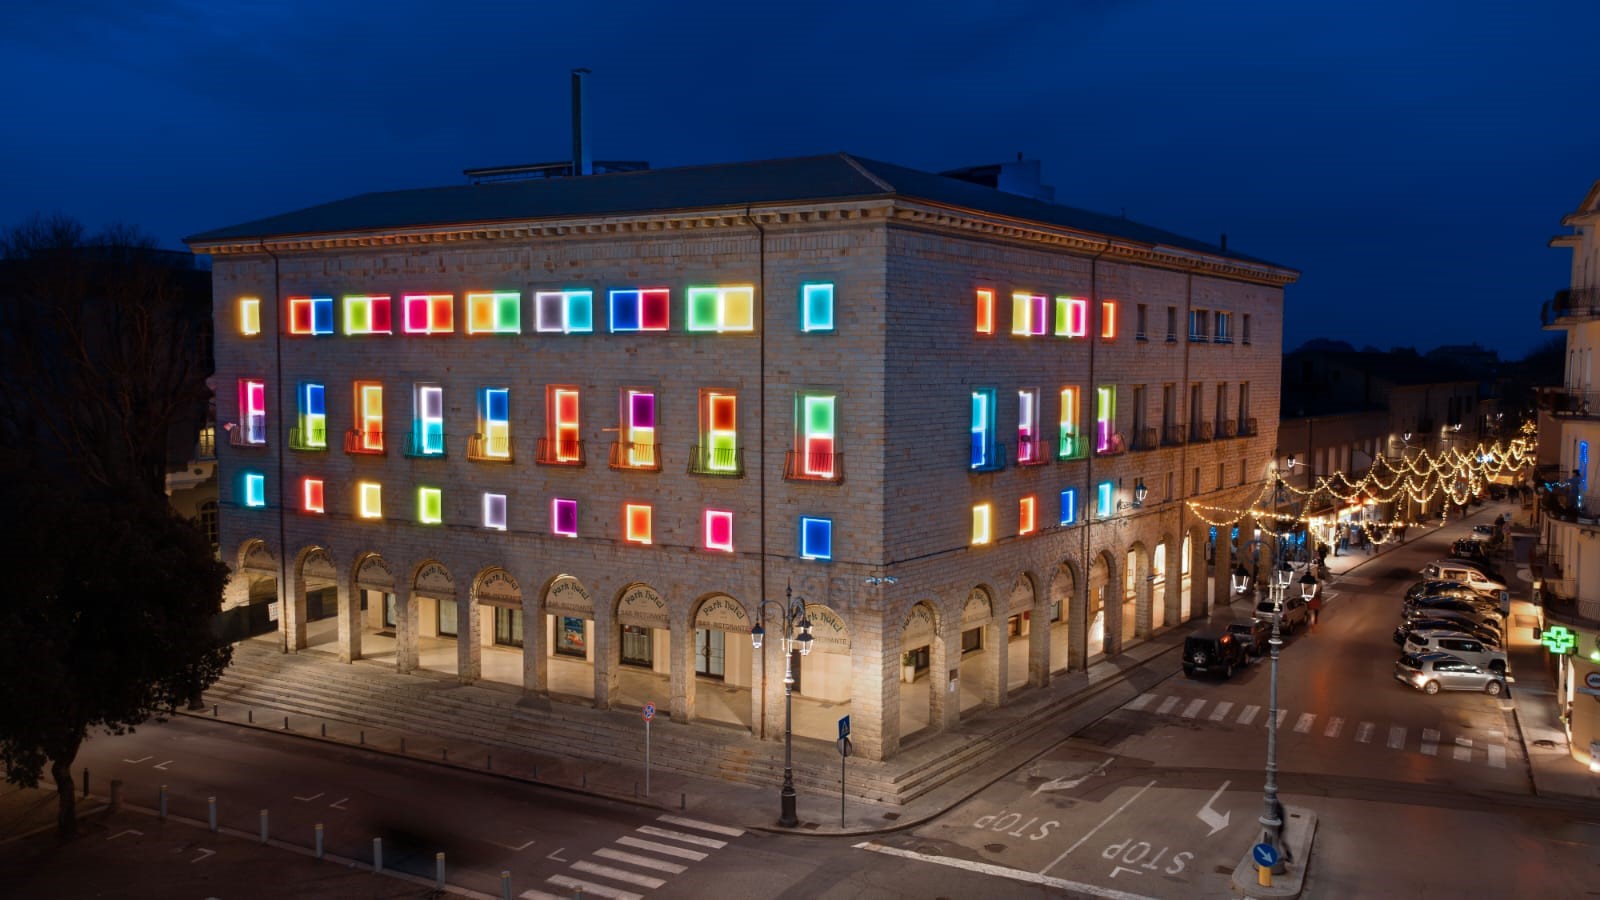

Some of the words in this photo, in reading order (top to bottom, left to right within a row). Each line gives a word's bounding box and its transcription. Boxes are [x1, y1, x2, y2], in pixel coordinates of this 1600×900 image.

[625, 590, 642, 605] Park
[703, 600, 722, 616] Park
[973, 810, 1060, 841] STOP
[1102, 838, 1194, 874] STOP
